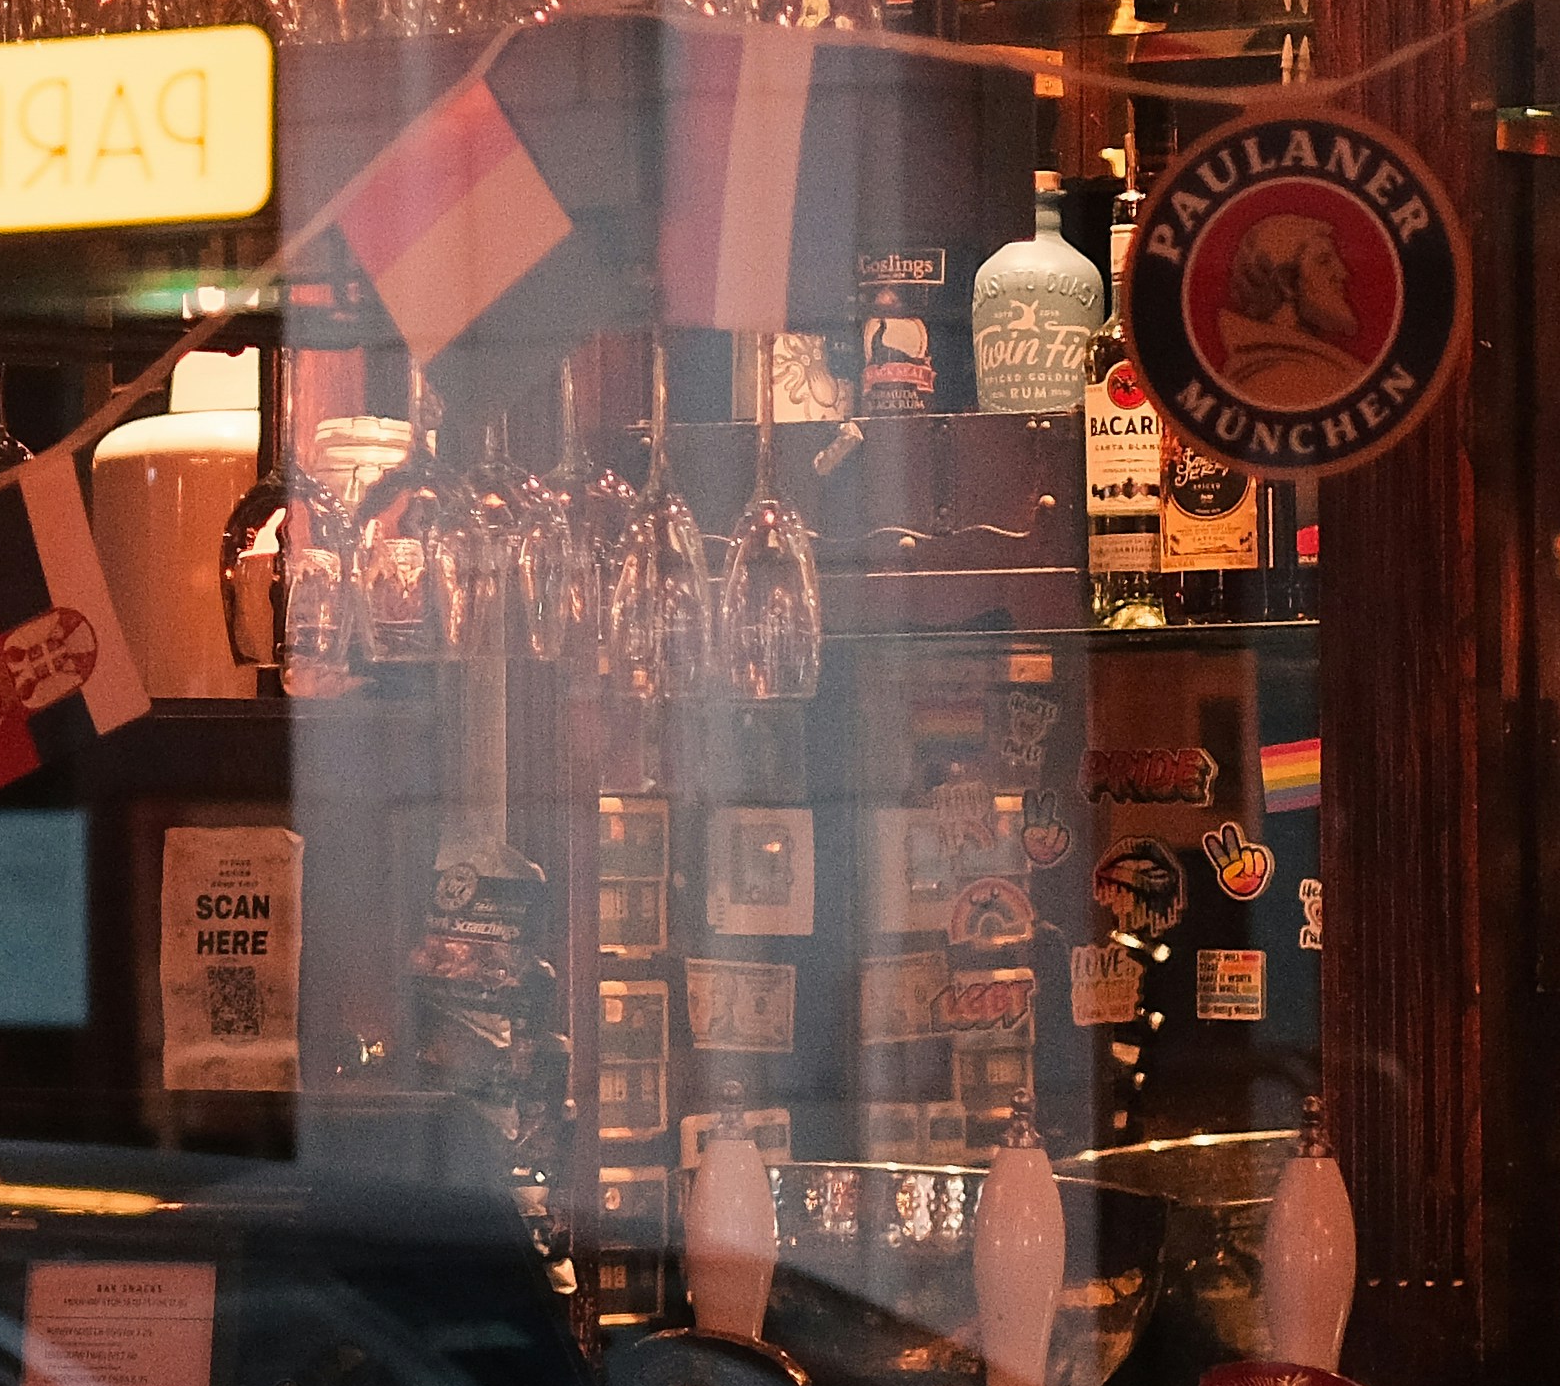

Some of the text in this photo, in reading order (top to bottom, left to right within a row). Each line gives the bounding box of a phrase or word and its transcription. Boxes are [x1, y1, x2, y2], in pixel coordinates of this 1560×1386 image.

[1147, 130, 1430, 265] PAULANER
[1028, 371, 1080, 384] GOLDEN
[1010, 385, 1049, 400] RUM
[1176, 363, 1416, 455] MÜNCHEN
[1090, 415, 1161, 436] BACAR
[1083, 745, 1206, 803] PRIDE
[195, 894, 270, 920] SCAN
[196, 929, 270, 956] HERE
